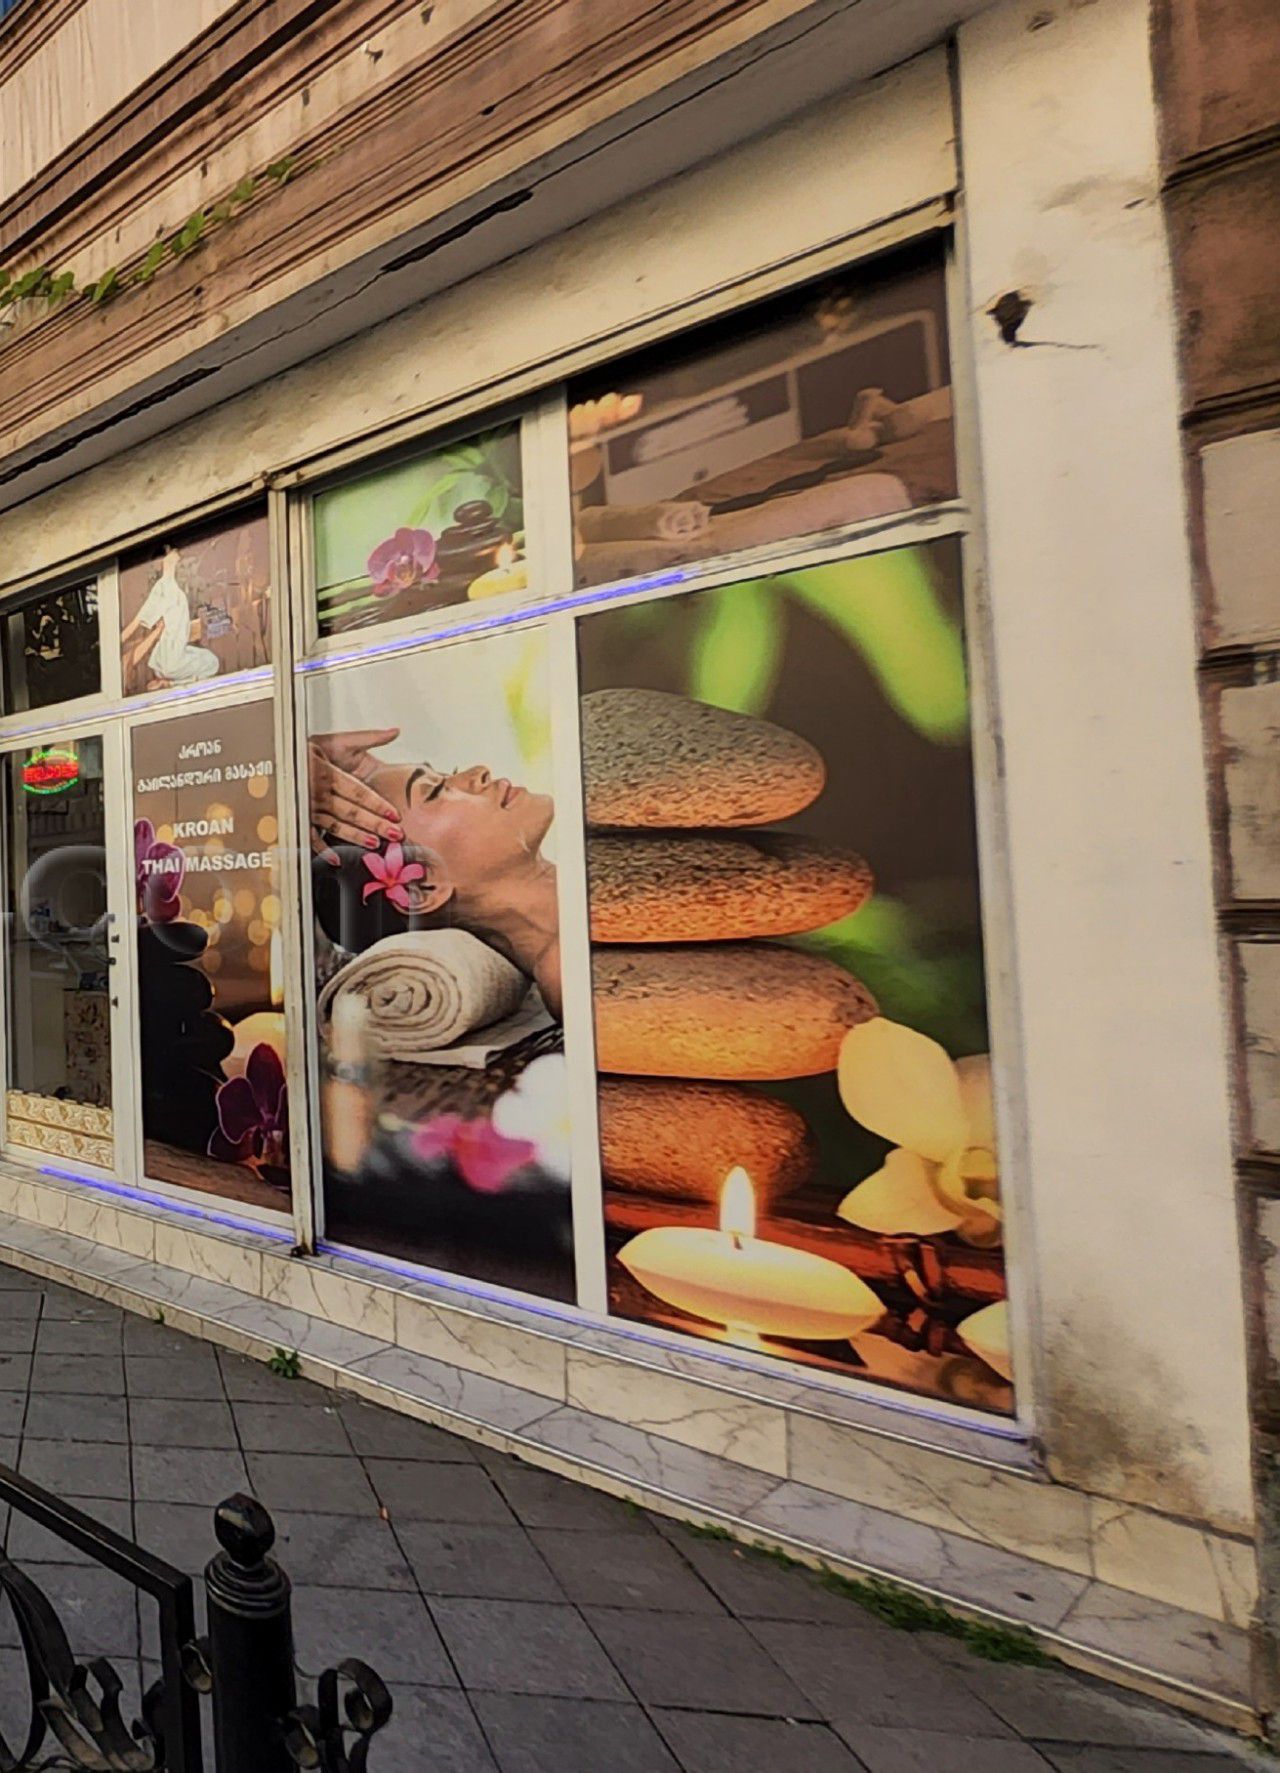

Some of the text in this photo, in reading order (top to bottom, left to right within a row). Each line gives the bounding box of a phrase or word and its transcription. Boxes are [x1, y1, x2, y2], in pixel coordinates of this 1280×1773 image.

[173, 817, 234, 839] KROAN
[141, 851, 274, 875] THAI MASSAGE
